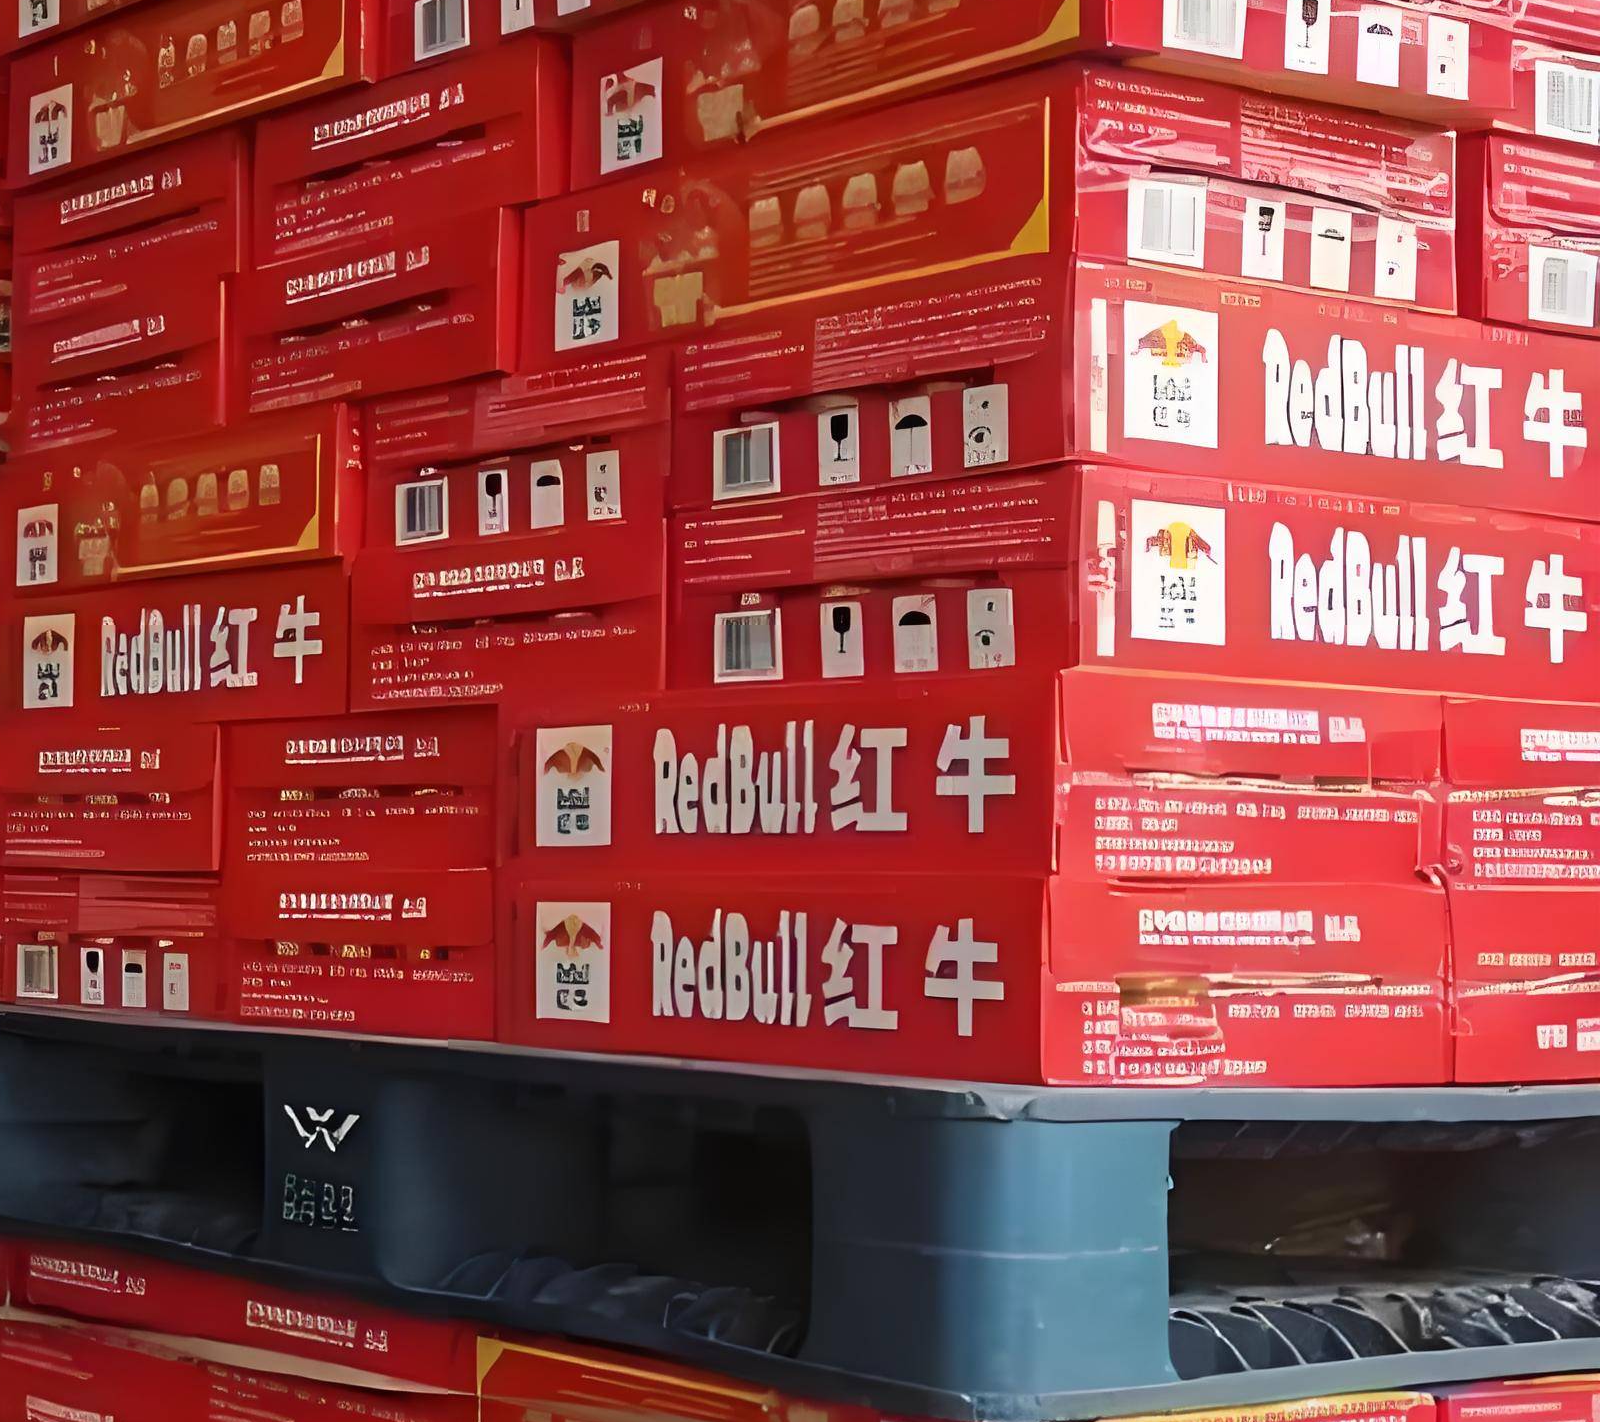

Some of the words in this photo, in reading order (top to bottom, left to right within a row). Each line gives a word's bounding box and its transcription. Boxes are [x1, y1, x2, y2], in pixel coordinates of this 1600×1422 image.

[1263, 329, 1427, 460] RedBull
[1435, 358, 1587, 477] 红牛
[1269, 522, 1429, 650] RedBull
[1438, 547, 1587, 663] 红牛
[654, 720, 817, 834] RedBull
[829, 716, 1015, 833] 红牛
[651, 909, 811, 1027] RedBull
[821, 918, 1004, 1036] 红牛
